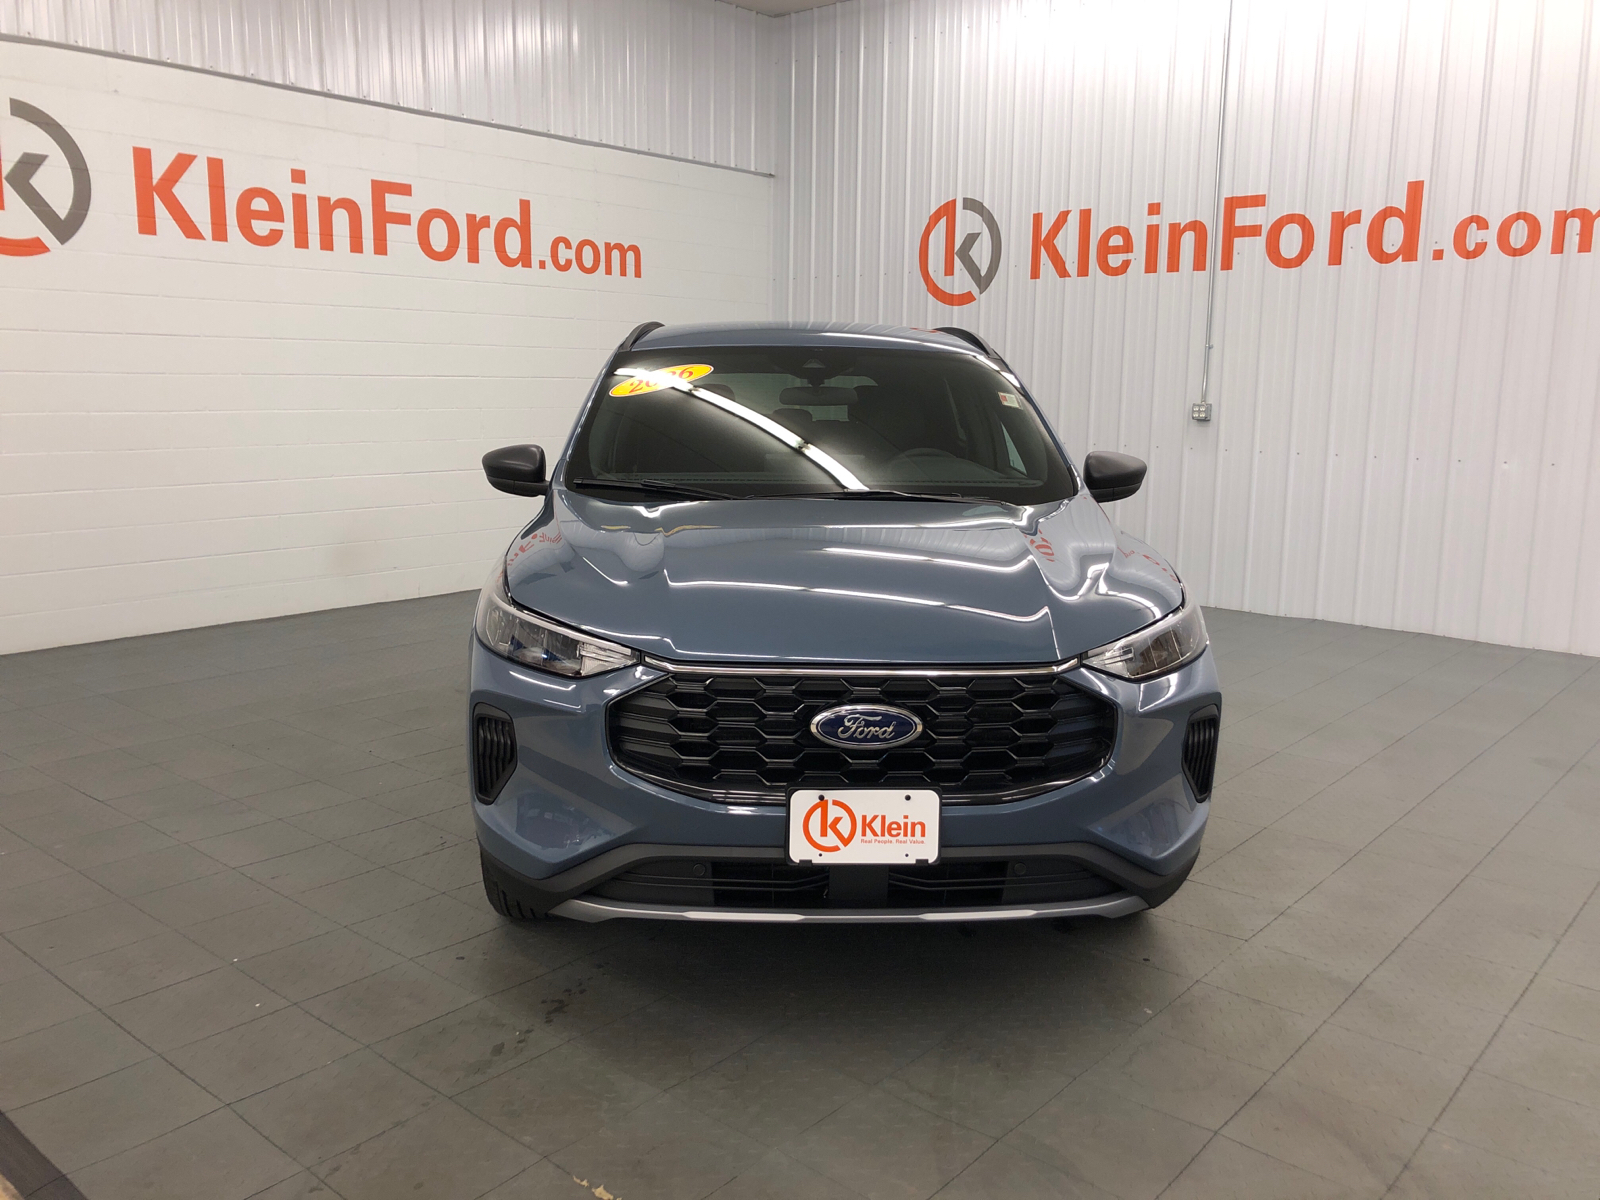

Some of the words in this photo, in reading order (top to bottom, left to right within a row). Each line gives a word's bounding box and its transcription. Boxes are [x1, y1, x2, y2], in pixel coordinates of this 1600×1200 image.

[132, 146, 642, 279] KleinFord.com
[1030, 180, 1600, 281] KleinFord.com
[628, 366, 694, 393] 26
[837, 714, 897, 739] Ford
[861, 814, 926, 838] Klein
